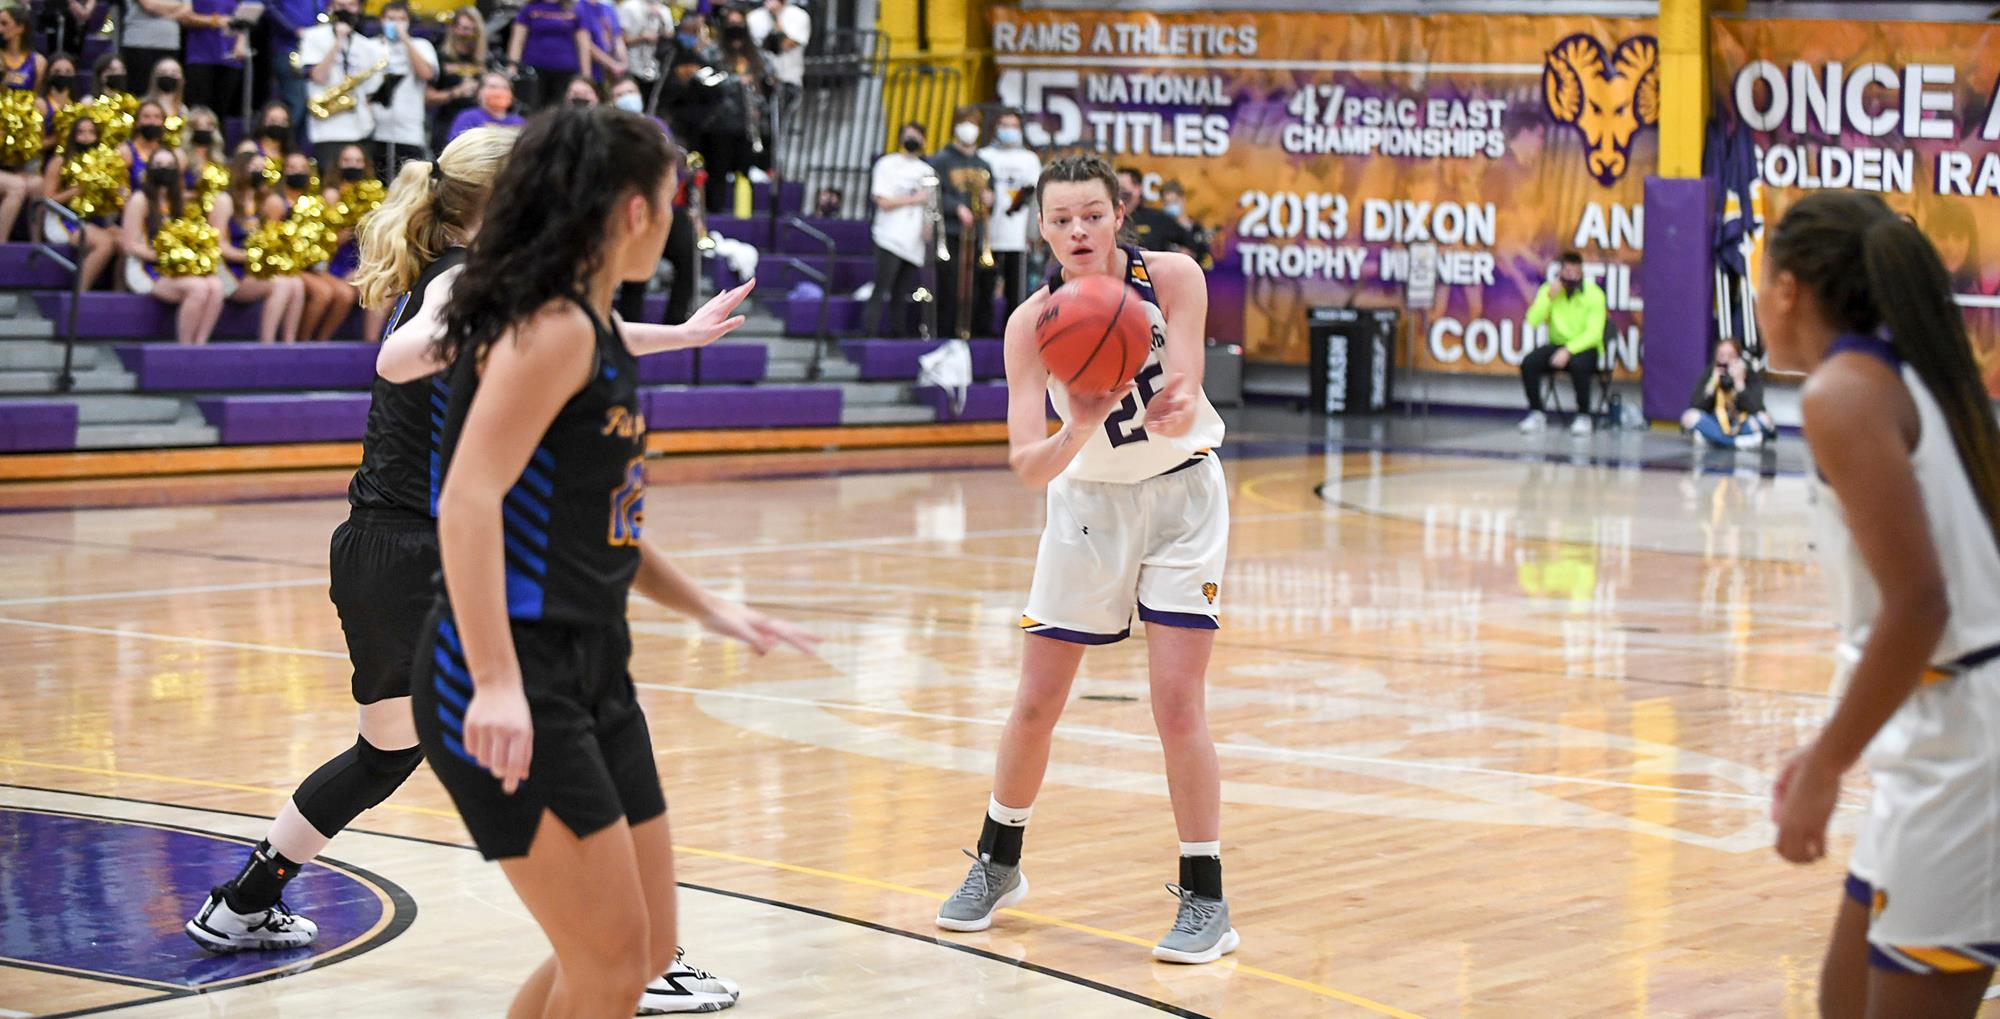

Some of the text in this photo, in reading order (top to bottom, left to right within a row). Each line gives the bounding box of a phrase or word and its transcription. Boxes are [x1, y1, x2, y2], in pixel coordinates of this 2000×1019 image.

[993, 22, 1258, 55] RAMS ATHLETICS
[1087, 73, 1232, 105] NATIONAL
[1735, 60, 1956, 139] ONCE
[1087, 111, 1232, 157] TITLES
[1426, 99, 1507, 130] EAST
[1283, 124, 1506, 158] CHAMPIONSHIPS
[1754, 144, 1915, 193] OLDEN
[1238, 190, 1496, 246] 2013 DIXON
[1236, 242, 1368, 281] TROPHY
[1380, 247, 1495, 286] WINER
